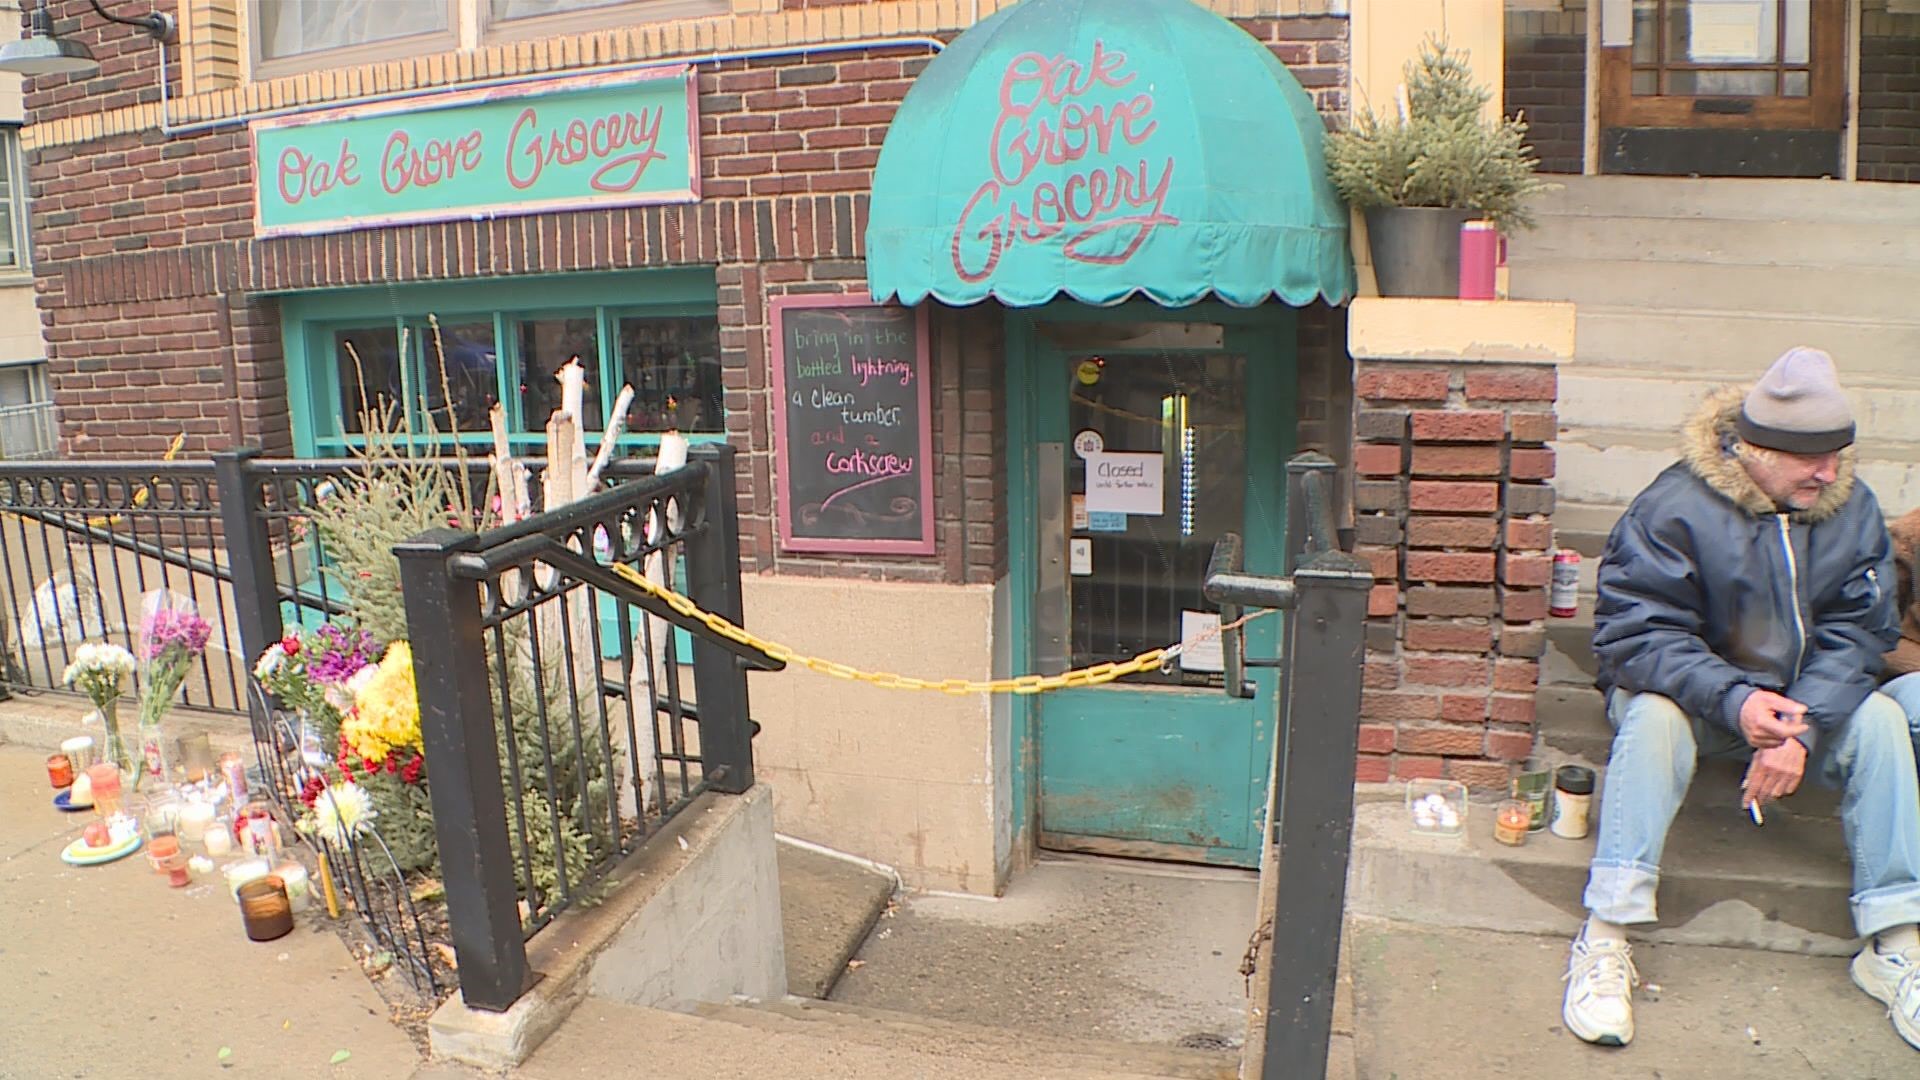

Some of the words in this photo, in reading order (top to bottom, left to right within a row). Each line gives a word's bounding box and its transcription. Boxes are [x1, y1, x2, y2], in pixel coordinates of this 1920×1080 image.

[1000, 38, 1136, 107] Oak
[277, 137, 361, 204] Oak
[379, 129, 483, 194] Grove
[505, 106, 667, 192] Grocery
[990, 94, 1157, 186] Grove
[951, 156, 1180, 284] Grocery
[794, 327, 840, 359] bring
[844, 330, 864, 347] in
[874, 327, 907, 345] the
[795, 355, 842, 379] bottled
[791, 389, 804, 408] a
[810, 424, 845, 446] and
[1097, 461, 1144, 477] Closed
